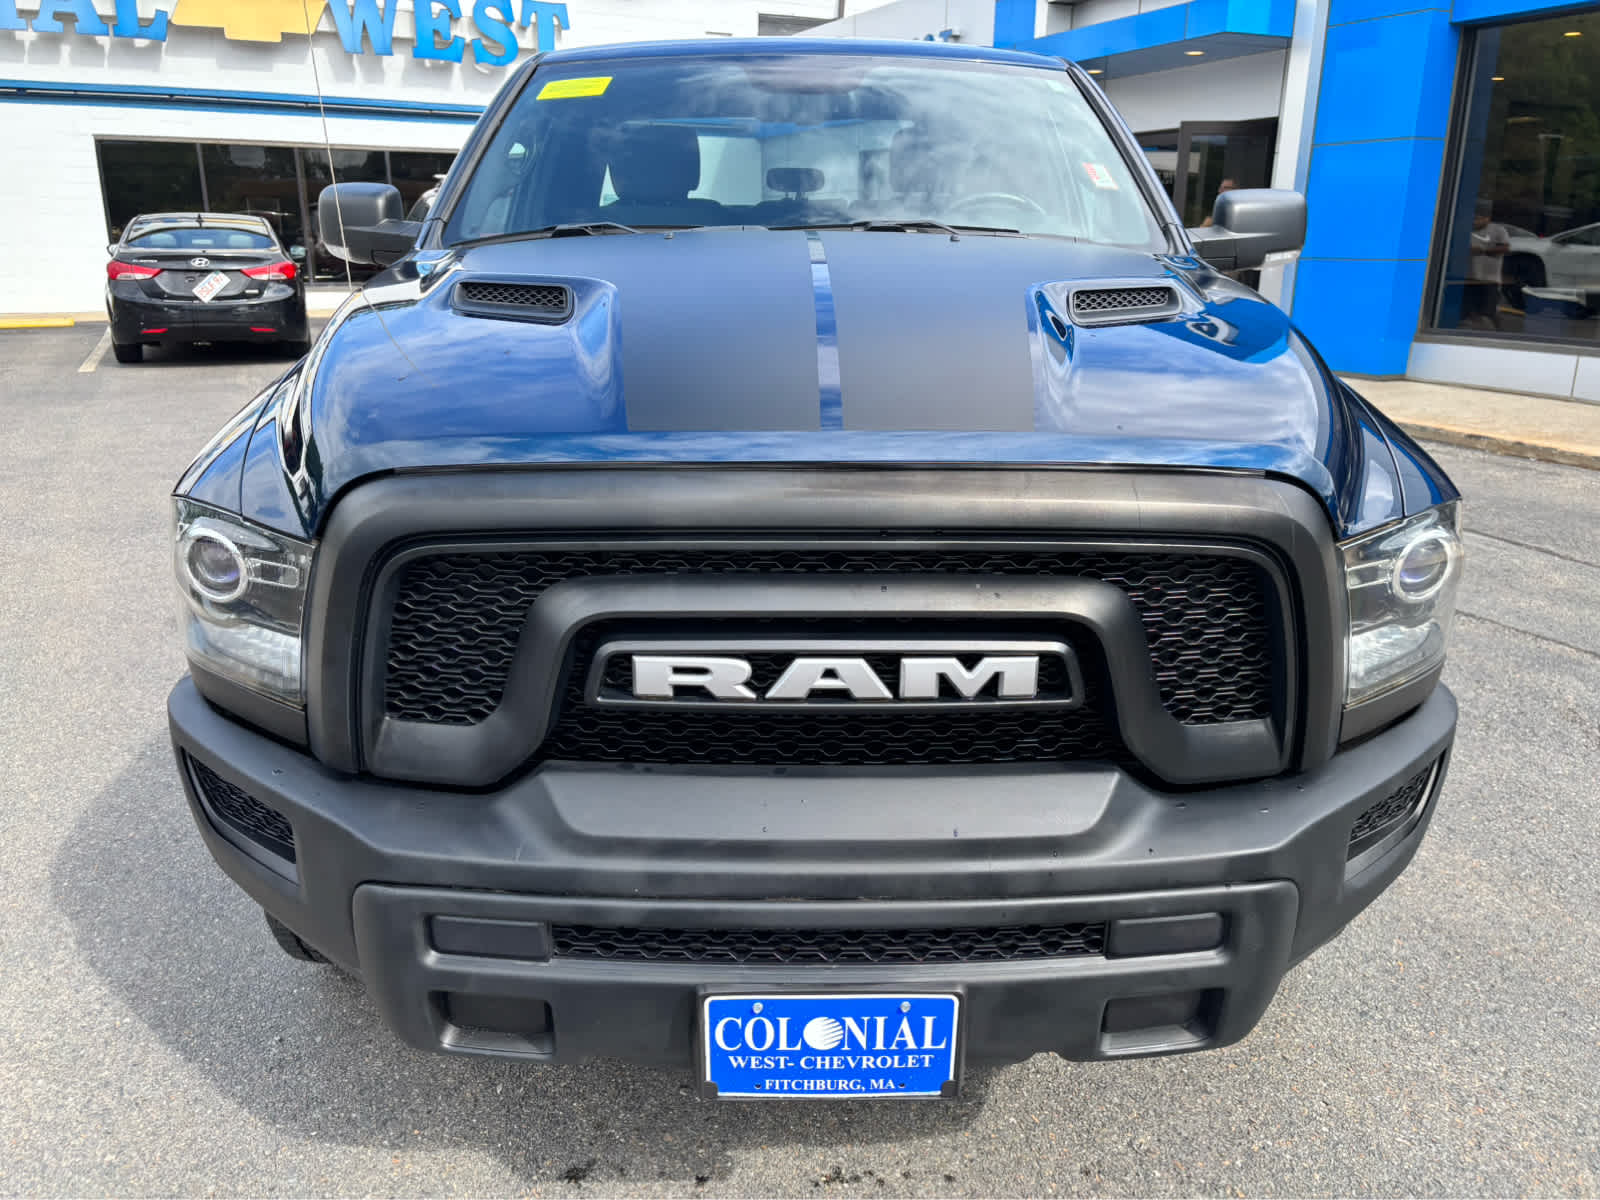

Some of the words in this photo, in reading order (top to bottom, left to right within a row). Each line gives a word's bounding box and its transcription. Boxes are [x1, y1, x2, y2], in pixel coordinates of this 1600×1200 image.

[323, 0, 570, 67] WEST
[631, 655, 1040, 699] RAM
[714, 1015, 947, 1051] COLONIAL
[800, 1054, 935, 1070] CHEVROLET
[765, 1078, 866, 1092] FITCHBURG,
[870, 1078, 896, 1090] MA
